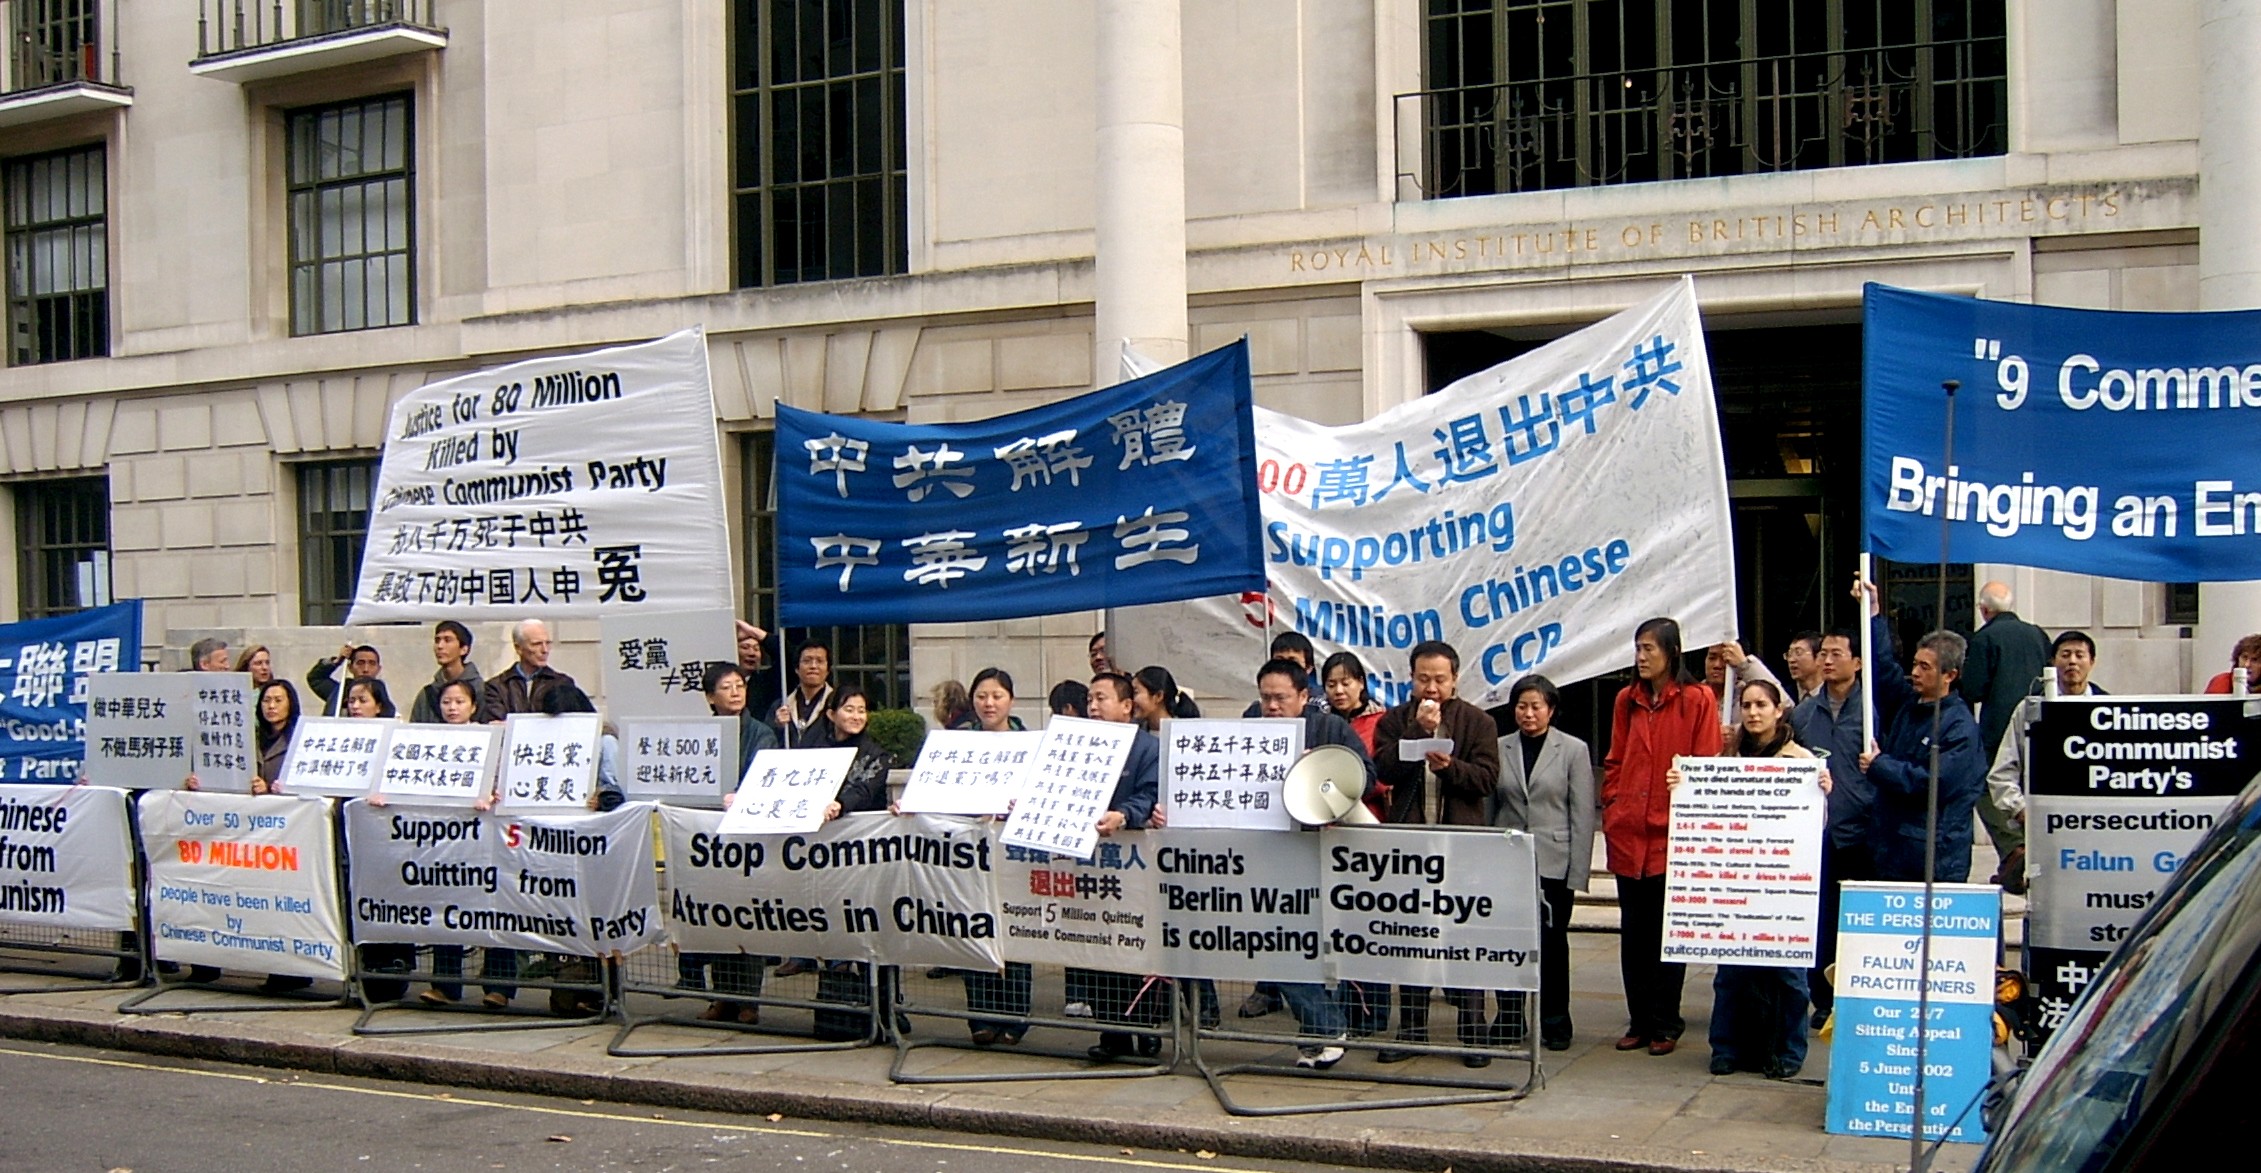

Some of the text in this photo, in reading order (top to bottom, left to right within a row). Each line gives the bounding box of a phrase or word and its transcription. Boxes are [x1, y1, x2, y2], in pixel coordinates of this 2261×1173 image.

[1292, 192, 2119, 272] ROYAL INSTITUTE OF BRITISH ARCHITECTS
[399, 371, 621, 440] Justice for 80 Million
[424, 428, 519, 471] Killed by
[804, 400, 1197, 502] 中共解體
[381, 456, 666, 511] Chinese Communist Party
[1887, 456, 2099, 540] Bringing
[2111, 494, 2177, 538] an
[811, 505, 1199, 592] 中華新生
[1266, 502, 1513, 581] Supporting
[1295, 597, 1443, 648] Million
[1459, 538, 1630, 628] Chinese
[619, 637, 670, 671] 愛黨
[1481, 622, 1563, 685] CCP
[0, 638, 120, 707] 聯盟
[93, 697, 166, 719] 做中華兒女
[2090, 707, 2210, 730] Chinese
[101, 737, 184, 758] 不做馬列子孫
[1176, 735, 1288, 756] 中華五千年文明
[2063, 735, 2237, 761] Communist
[1175, 764, 1287, 783] 中共五十年暴政
[1703, 764, 1715, 772] 50
[1744, 765, 1755, 773] 80
[1787, 766, 1816, 776] people
[1711, 775, 1729, 783] died
[2088, 765, 2193, 794] Party's
[1174, 789, 1270, 811] 中共不是中國
[184, 809, 286, 831] Over 50 years
[2047, 810, 2213, 834] persecution
[391, 815, 607, 856] Support 5 Million
[177, 841, 299, 871] 80 MILLION
[690, 831, 990, 877] Stop Communist
[1156, 846, 1244, 876] China's
[1331, 845, 1445, 884] Saying
[2060, 848, 2134, 871] Falun
[401, 861, 576, 898] Quitting from
[1030, 869, 1122, 900] 退出中共
[160, 886, 311, 914] people have been killed
[672, 887, 995, 939] Atrocities in China
[1158, 883, 1320, 915] "Berlin Wall"
[1331, 883, 1493, 924] Good-bye
[1884, 895, 1953, 910] TO SOP
[2086, 890, 2155, 910] must
[226, 914, 243, 933] by
[358, 897, 647, 941] Chinese Communist Party
[1003, 902, 1144, 928] Support 5 Million Quitting
[1368, 918, 1440, 940] Chinese
[1845, 912, 1875, 926] THE
[160, 922, 333, 959] Chinese Communist Party
[1009, 925, 1146, 951] Chinese Communist Party
[1162, 922, 1320, 960] is collapsing
[1332, 927, 1366, 955] to
[1663, 944, 1814, 960] quitccp.epochtimes.com
[1904, 936, 1923, 954] of
[1365, 939, 1527, 967] Communist Party
[1862, 955, 1915, 970] FALUN
[1873, 1005, 1945, 1019] Our 2/7
[1855, 1023, 1905, 1041] Sitting
[1886, 1043, 1929, 1057] Sinc
[1859, 1062, 1953, 1077] 5 June 002
[1865, 1101, 1948, 1116] the En of
[1848, 1118, 1962, 1137] the Perseution
